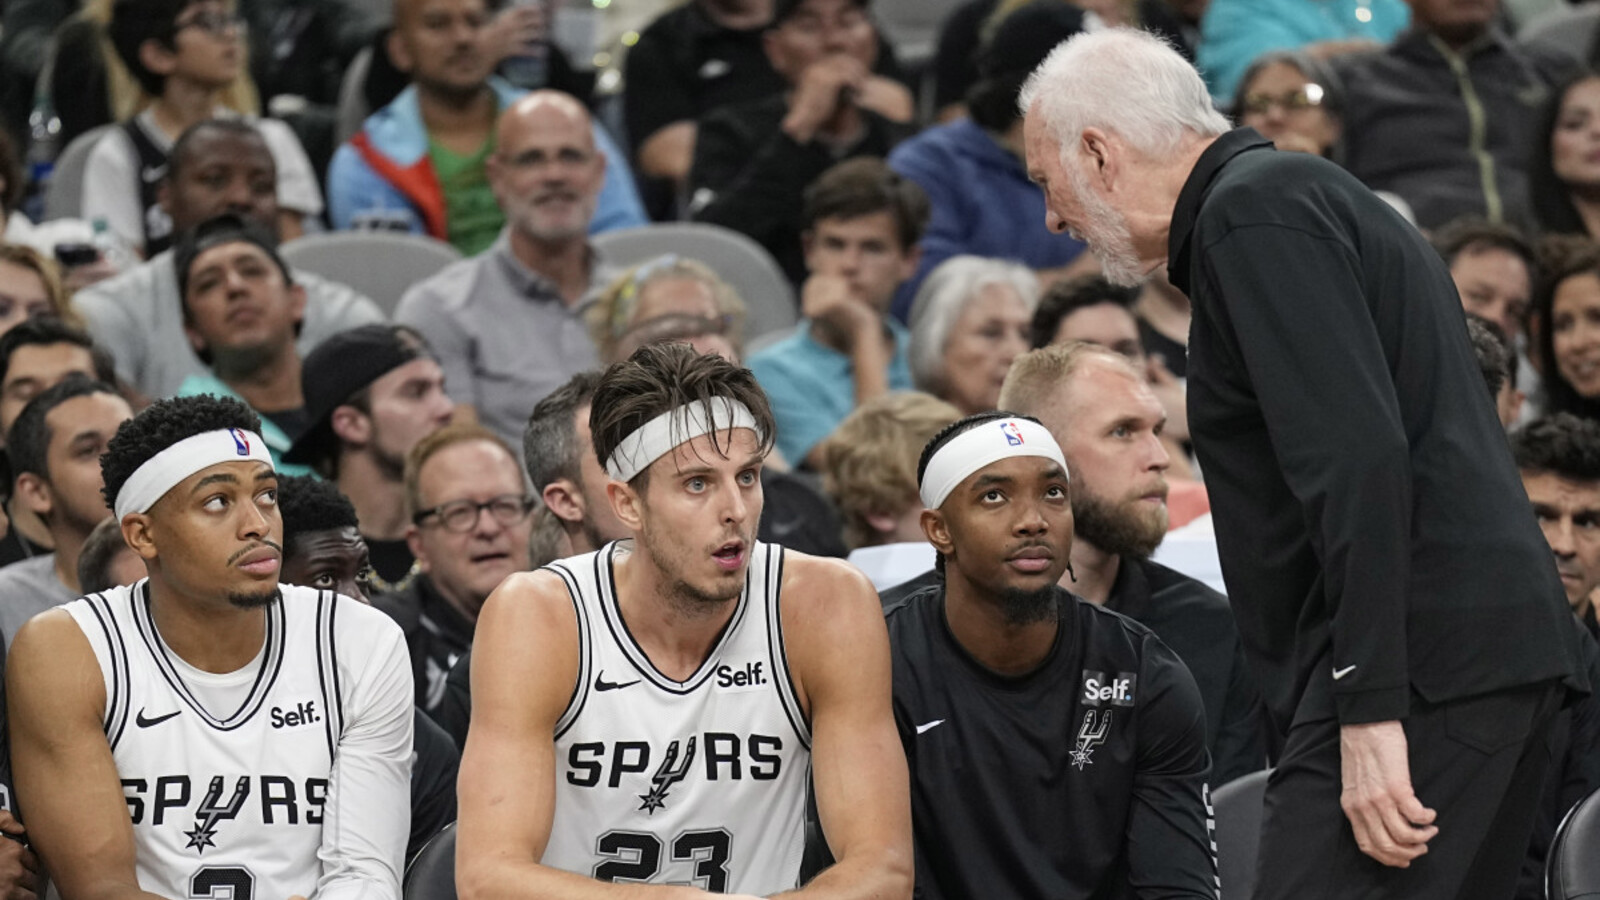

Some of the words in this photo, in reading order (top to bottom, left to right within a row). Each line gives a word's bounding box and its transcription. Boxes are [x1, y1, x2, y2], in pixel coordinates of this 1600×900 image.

[717, 661, 767, 688] Self.
[1085, 678, 1131, 701] Self.
[270, 701, 321, 729] Self.
[566, 732, 783, 815] SPURS
[592, 826, 733, 895] 23
